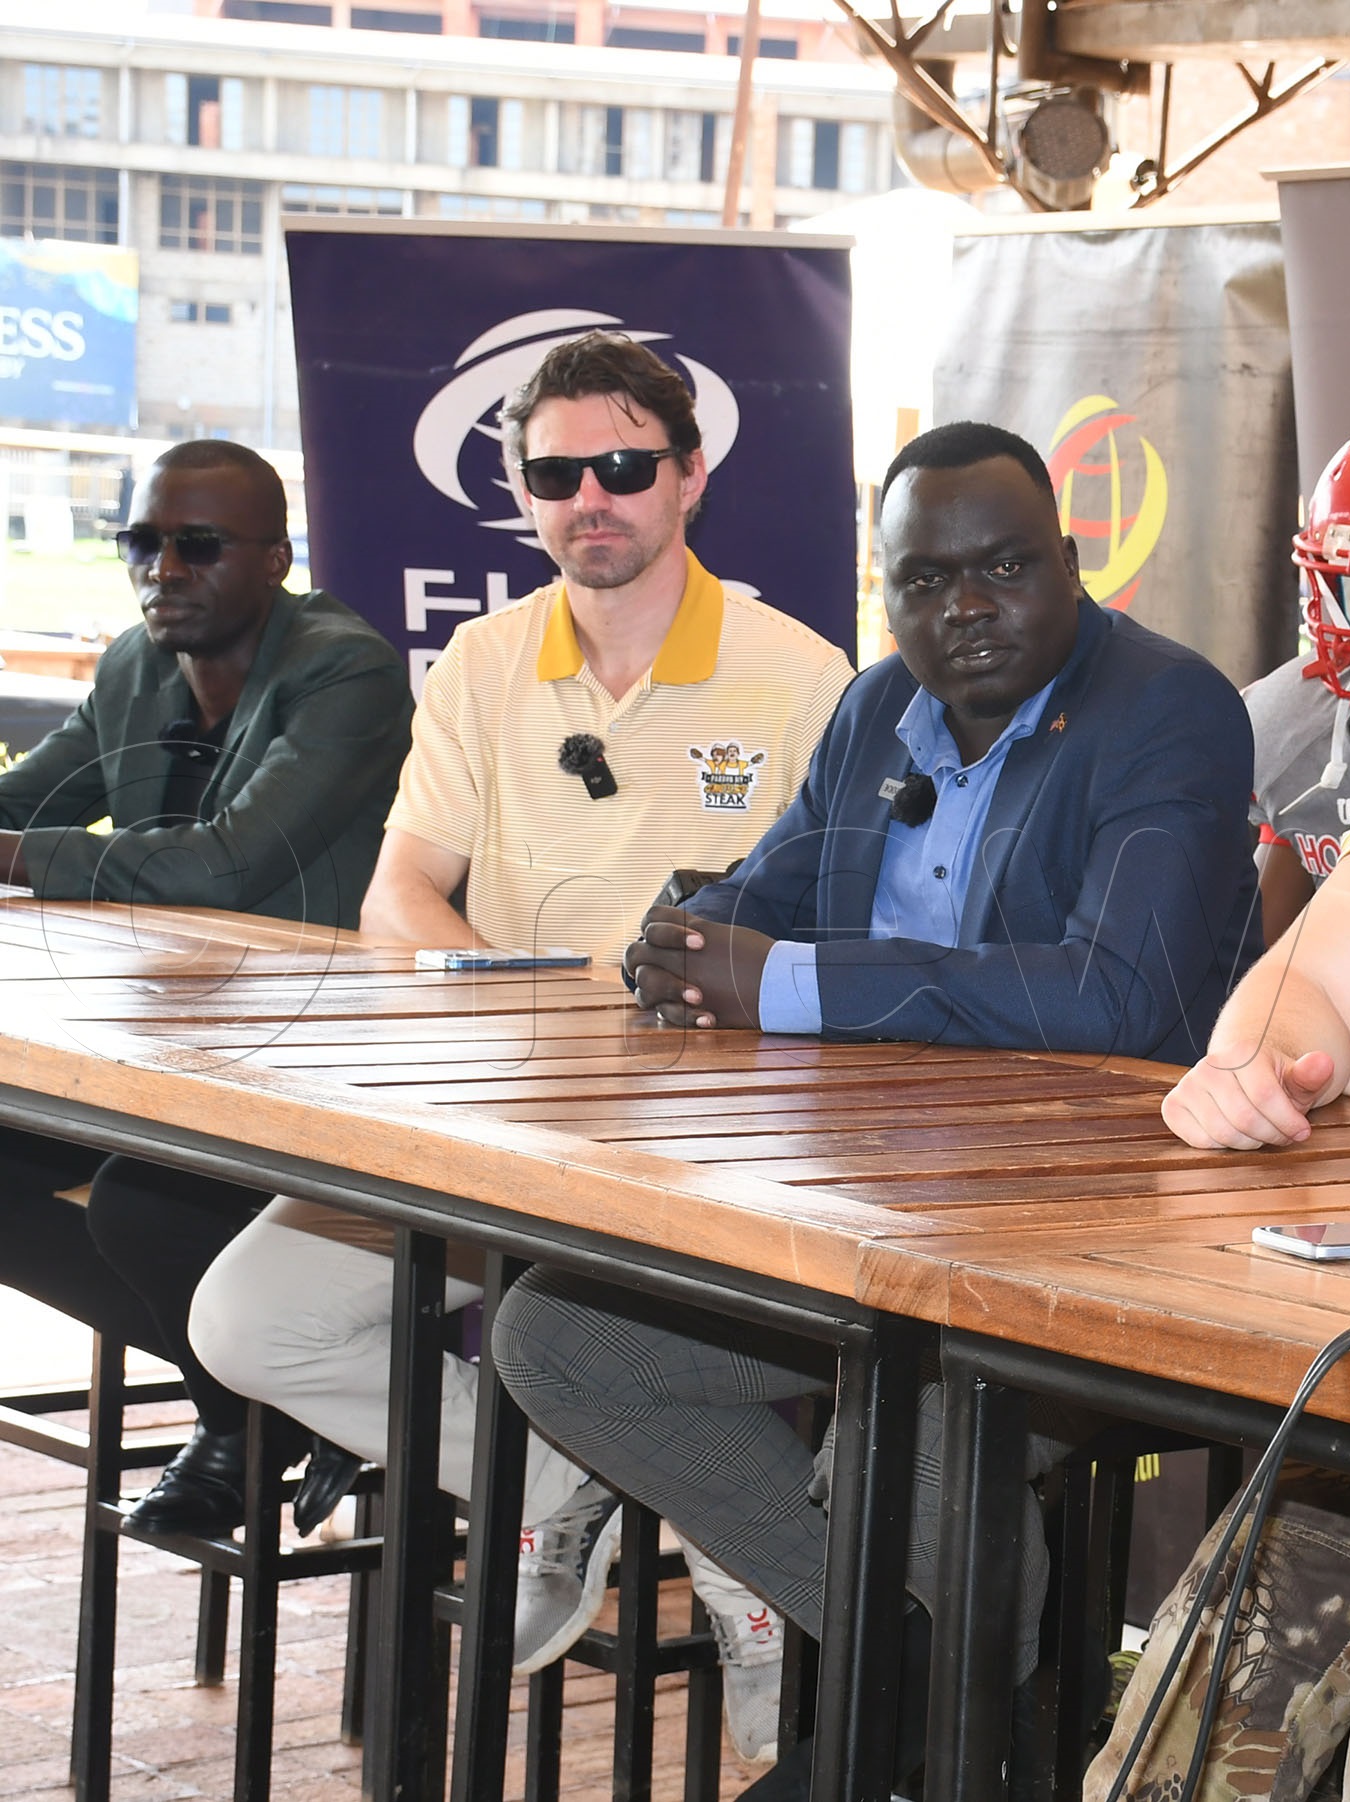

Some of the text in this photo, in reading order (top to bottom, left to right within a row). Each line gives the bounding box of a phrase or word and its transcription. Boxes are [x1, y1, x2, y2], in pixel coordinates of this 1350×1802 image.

[0, 306, 85, 361] ESS
[705, 793, 746, 805] STEAK
[1294, 832, 1342, 877] HO
